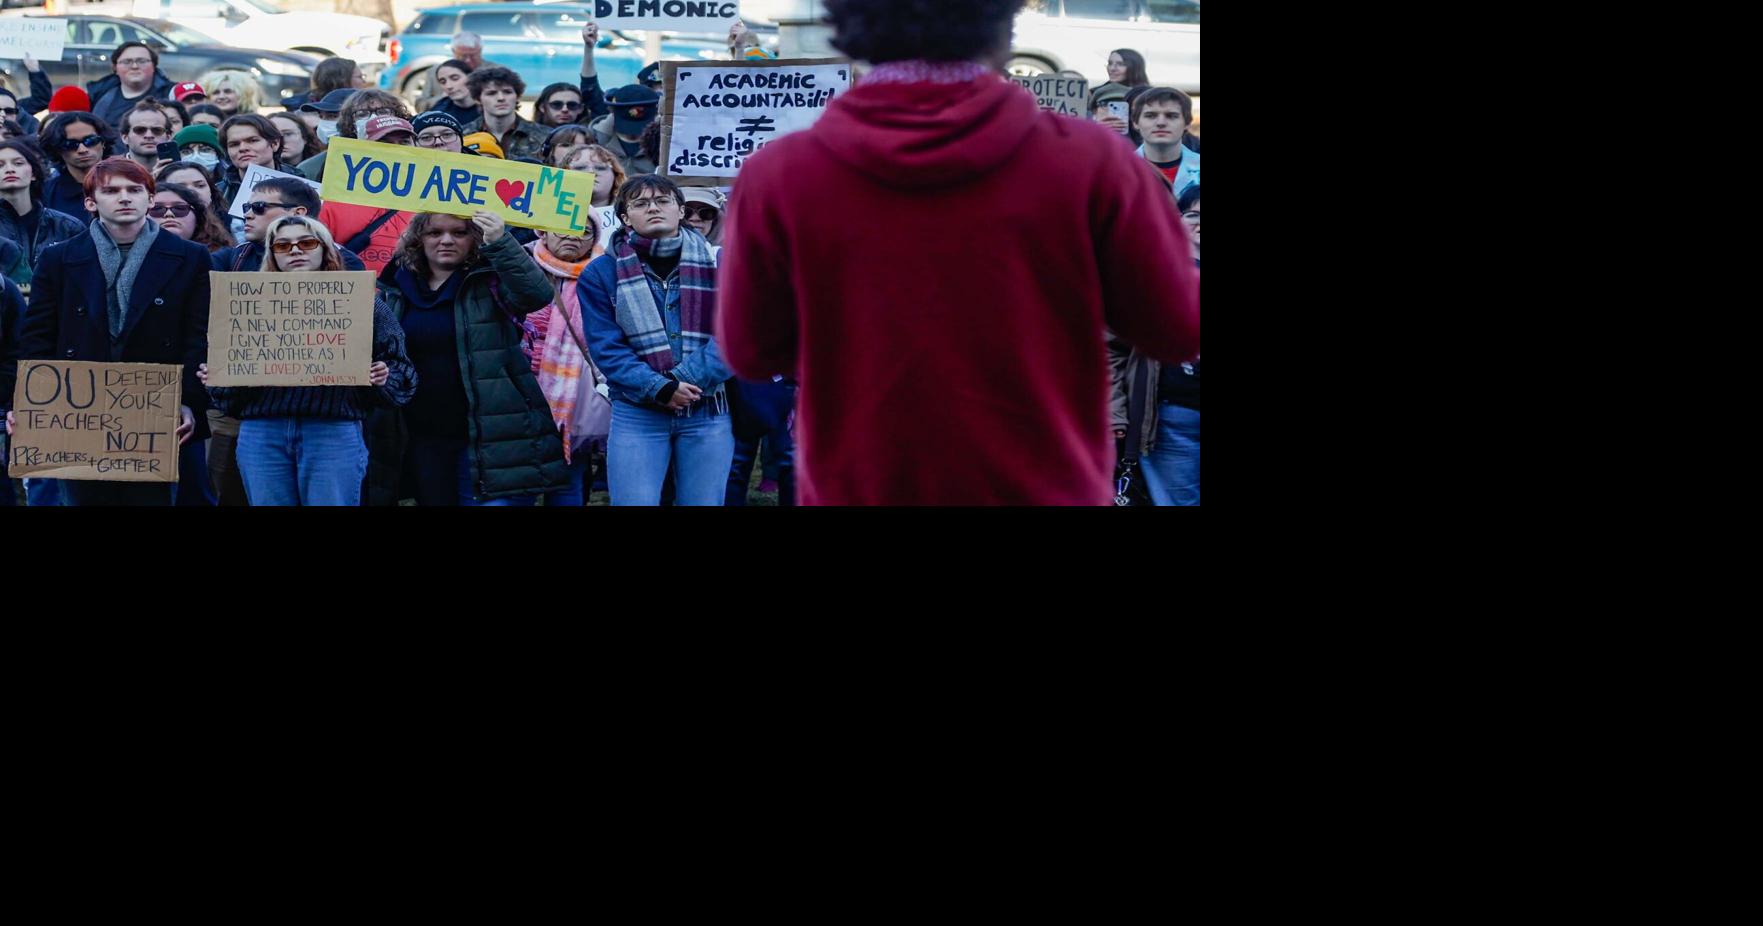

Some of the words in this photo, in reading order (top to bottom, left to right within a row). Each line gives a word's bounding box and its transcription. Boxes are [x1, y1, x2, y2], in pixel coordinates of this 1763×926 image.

[594, 0, 737, 18] DEMONIC
[698, 133, 774, 155] religi
[675, 150, 747, 168] discri
[343, 154, 416, 197] YOU
[420, 166, 489, 205] ARE
[230, 281, 265, 296] HOW
[269, 281, 291, 295] TO
[298, 281, 354, 295] PROPERLY
[230, 299, 263, 315] CITE
[269, 299, 299, 315] THE
[304, 298, 351, 316] BIBLE:
[247, 318, 276, 332] NEW
[283, 317, 352, 331] COMMAND
[230, 334, 233, 347] I
[237, 334, 271, 348] GIVE
[306, 332, 346, 346] LOVE
[228, 348, 253, 362] ONE
[256, 347, 314, 361] ANOTHER
[318, 347, 334, 361] AS
[342, 348, 346, 361] I
[105, 369, 178, 387] DEFEND
[227, 362, 258, 376] HAVE
[264, 362, 301, 376] LOVED
[25, 363, 96, 409] OU
[309, 375, 335, 385] JOHN
[105, 388, 162, 410] YOUR
[19, 409, 123, 432] TEACHERS
[106, 431, 167, 453] NOT
[13, 446, 87, 467] PREACHERS
[97, 457, 161, 473] GRIFTER
